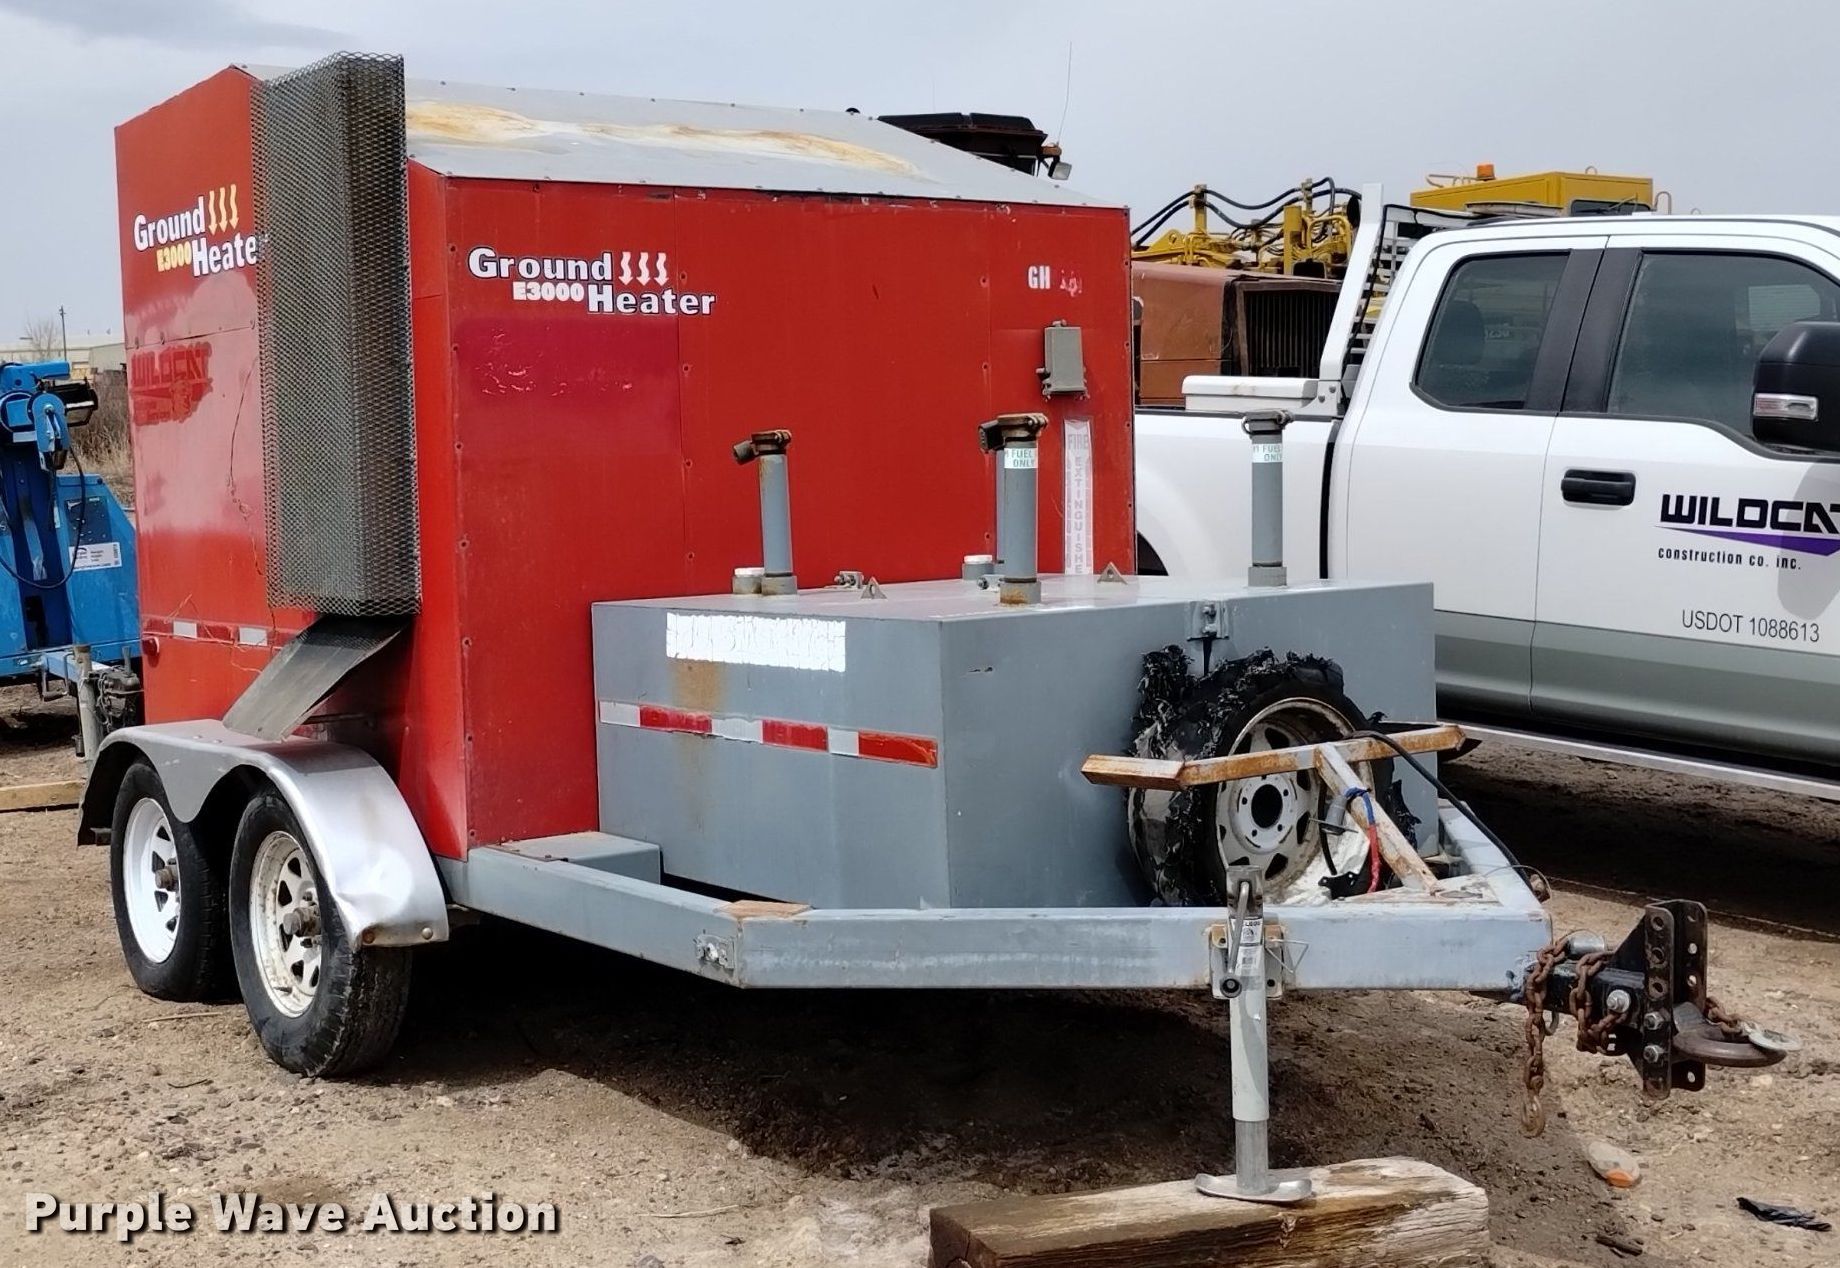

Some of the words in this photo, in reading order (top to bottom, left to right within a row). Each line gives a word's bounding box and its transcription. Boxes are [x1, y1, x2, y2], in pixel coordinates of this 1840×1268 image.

[134, 195, 206, 252] Ground
[156, 240, 192, 273] E3000
[468, 246, 613, 281] Ground
[512, 281, 585, 302] E3000
[587, 284, 717, 316] Heater
[1074, 456, 1084, 574] EXTINGUISHE
[1658, 547, 1743, 566] construction
[1749, 554, 1770, 568] co.
[1776, 555, 1802, 570] inc.
[1682, 609, 1743, 634] USDOT
[1749, 616, 1820, 643] 1088613
